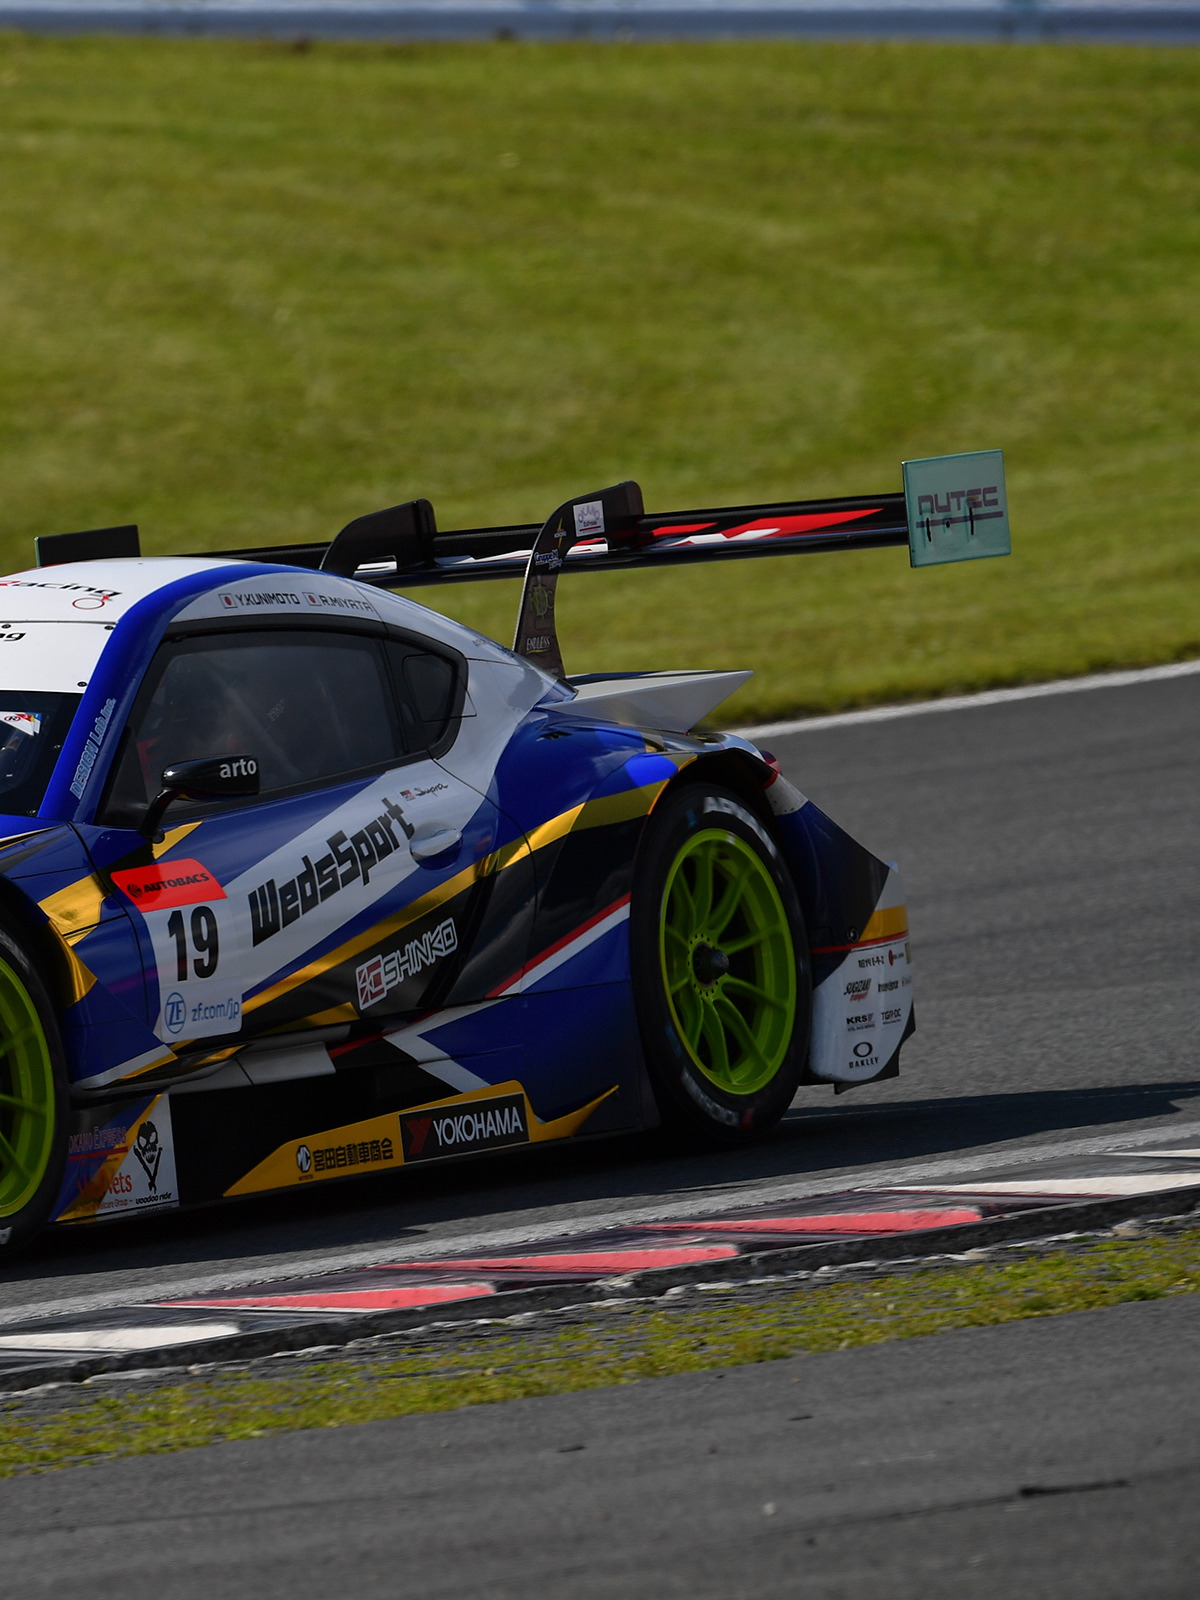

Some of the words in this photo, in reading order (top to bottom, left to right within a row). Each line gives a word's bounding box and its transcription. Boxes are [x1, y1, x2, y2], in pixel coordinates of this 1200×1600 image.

[234, 592, 301, 606] Y.KUNIMOTO
[319, 595, 375, 612] R.MIYATA
[69, 739, 99, 800] DESIGN
[219, 757, 258, 779] arto
[144, 873, 210, 893] AUTOBACS
[167, 905, 220, 982] 19
[383, 917, 458, 990] SHINKO
[191, 997, 240, 1024] zf.com/jp
[849, 1056, 879, 1069] OAKLEY
[432, 1106, 524, 1147] YOKOHAMA
[135, 1194, 159, 1205] voodoo
